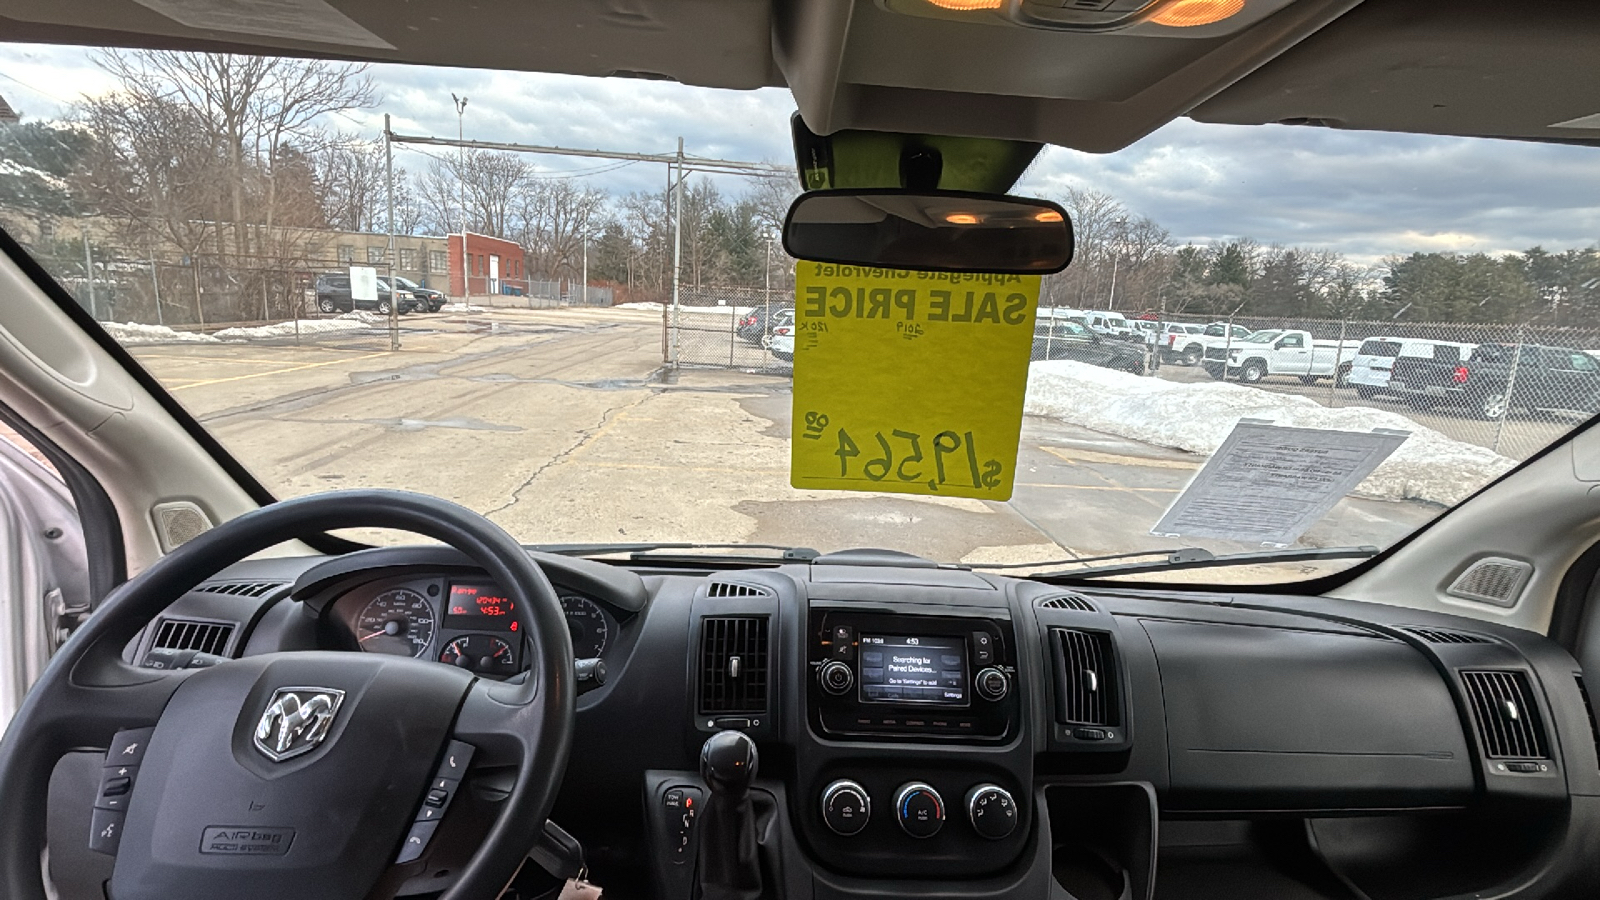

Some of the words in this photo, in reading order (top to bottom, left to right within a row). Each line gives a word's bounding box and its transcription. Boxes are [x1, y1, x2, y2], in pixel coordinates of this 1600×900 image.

[451, 586, 478, 596] Range
[906, 637, 919, 645] 4:53
[892, 655, 923, 666] Searching
[923, 656, 931, 664] for
[888, 664, 908, 673] Paired
[943, 691, 962, 699] Settings
[686, 798, 693, 808] P
